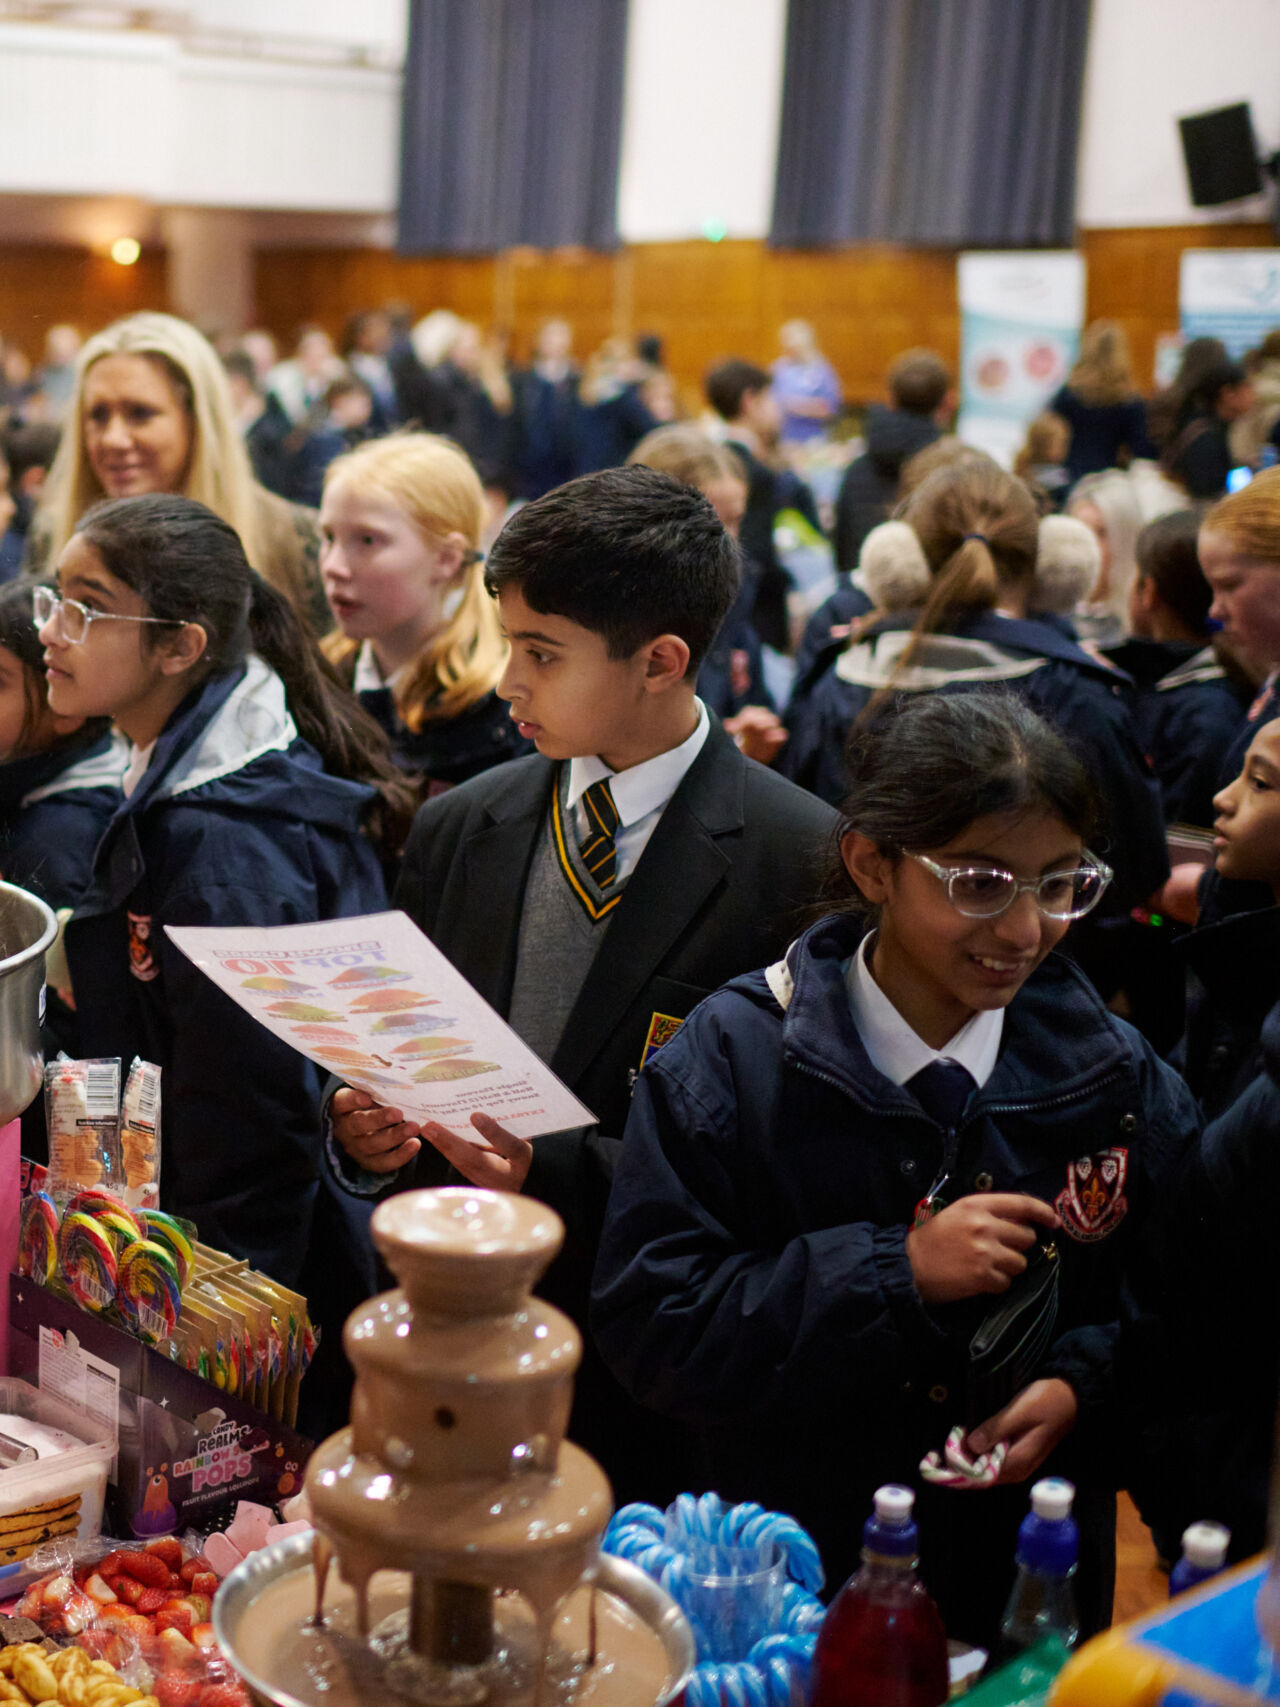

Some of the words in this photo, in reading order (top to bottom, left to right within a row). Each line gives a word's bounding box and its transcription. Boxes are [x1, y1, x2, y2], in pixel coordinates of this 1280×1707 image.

[199, 1426, 251, 1454] REALMS
[212, 1422, 236, 1435] CANDY
[173, 1447, 230, 1476] RAINBOW
[192, 1456, 252, 1493] POPS
[182, 1496, 201, 1506] FRUIT
[201, 1488, 228, 1501] FLAVOUR
